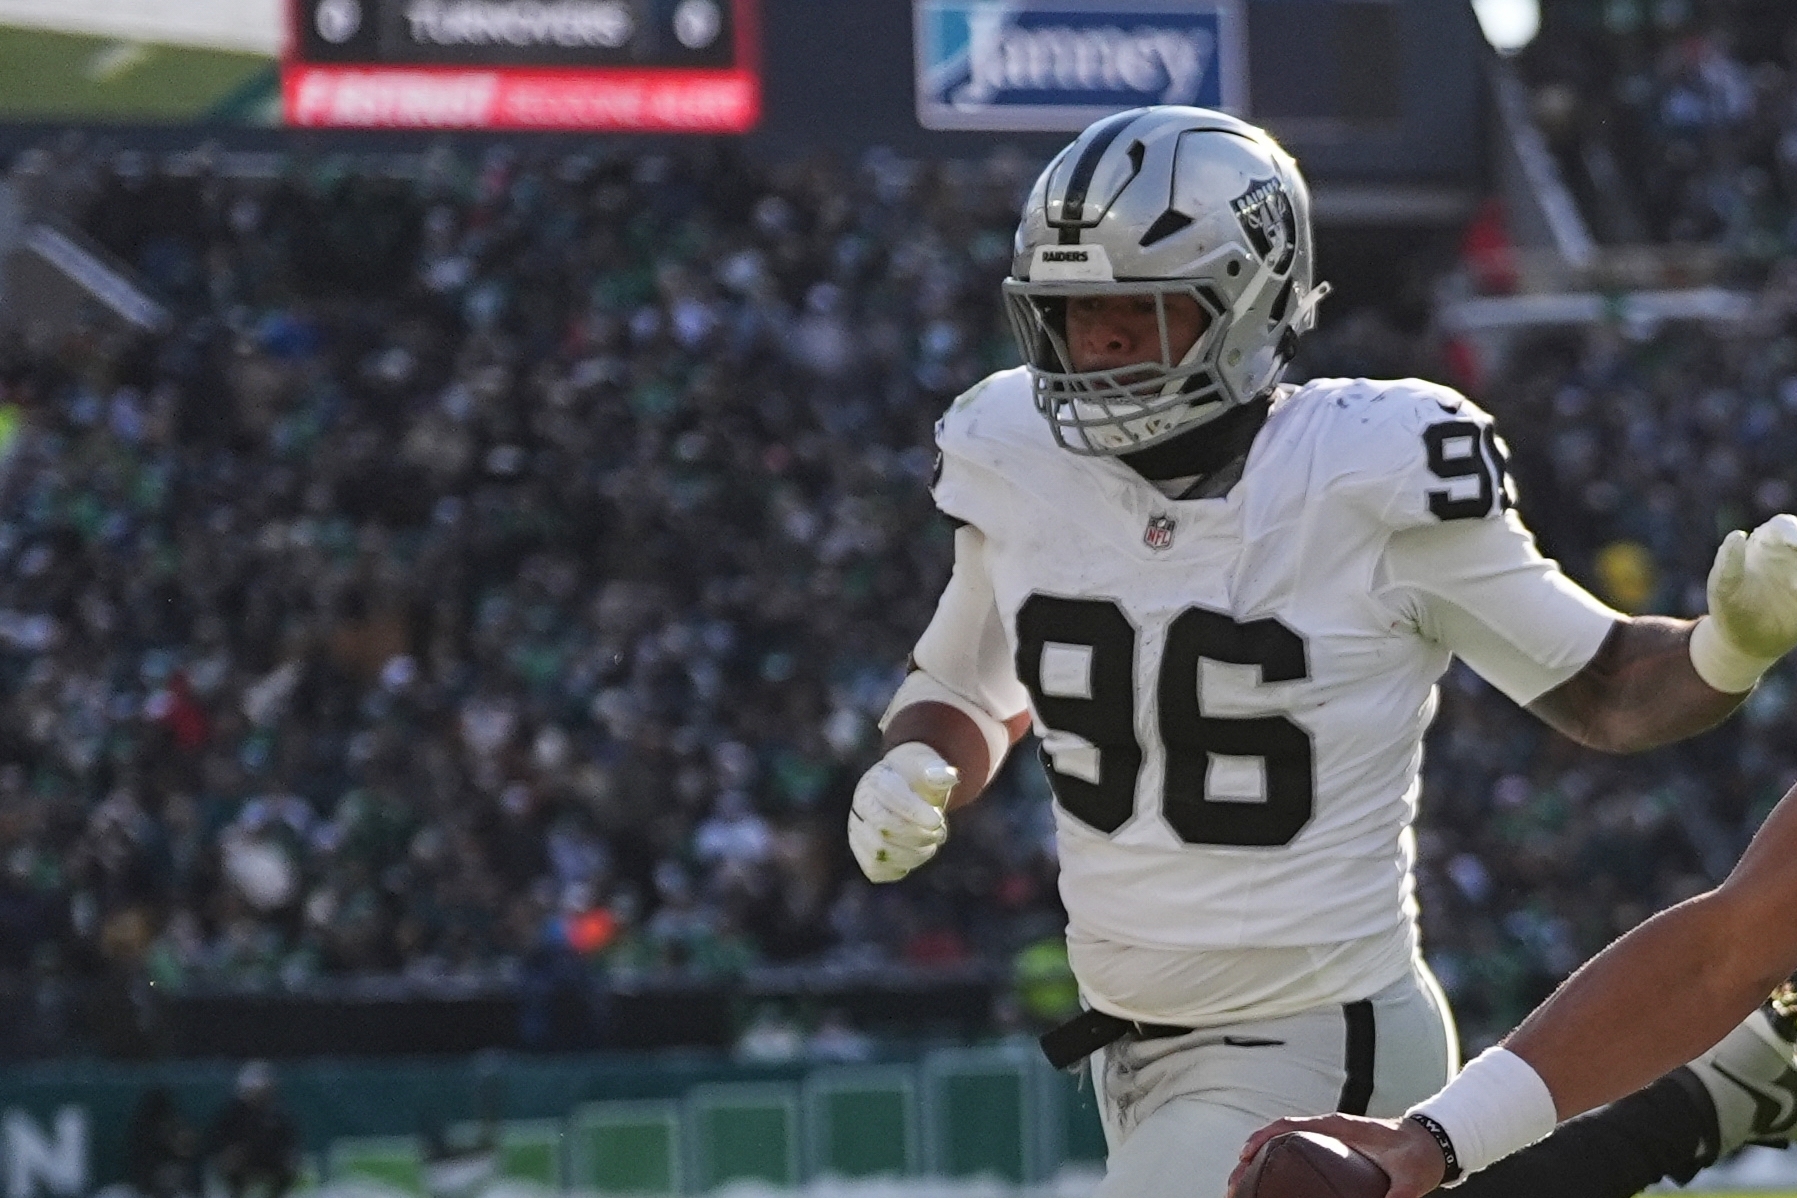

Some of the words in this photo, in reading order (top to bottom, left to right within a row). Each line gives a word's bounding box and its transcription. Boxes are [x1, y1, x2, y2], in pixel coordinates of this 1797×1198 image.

[952, 8, 1212, 114] Janney
[1041, 250, 1089, 262] RAIDERS
[1422, 420, 1512, 520] 9
[1014, 591, 1318, 848] 96
